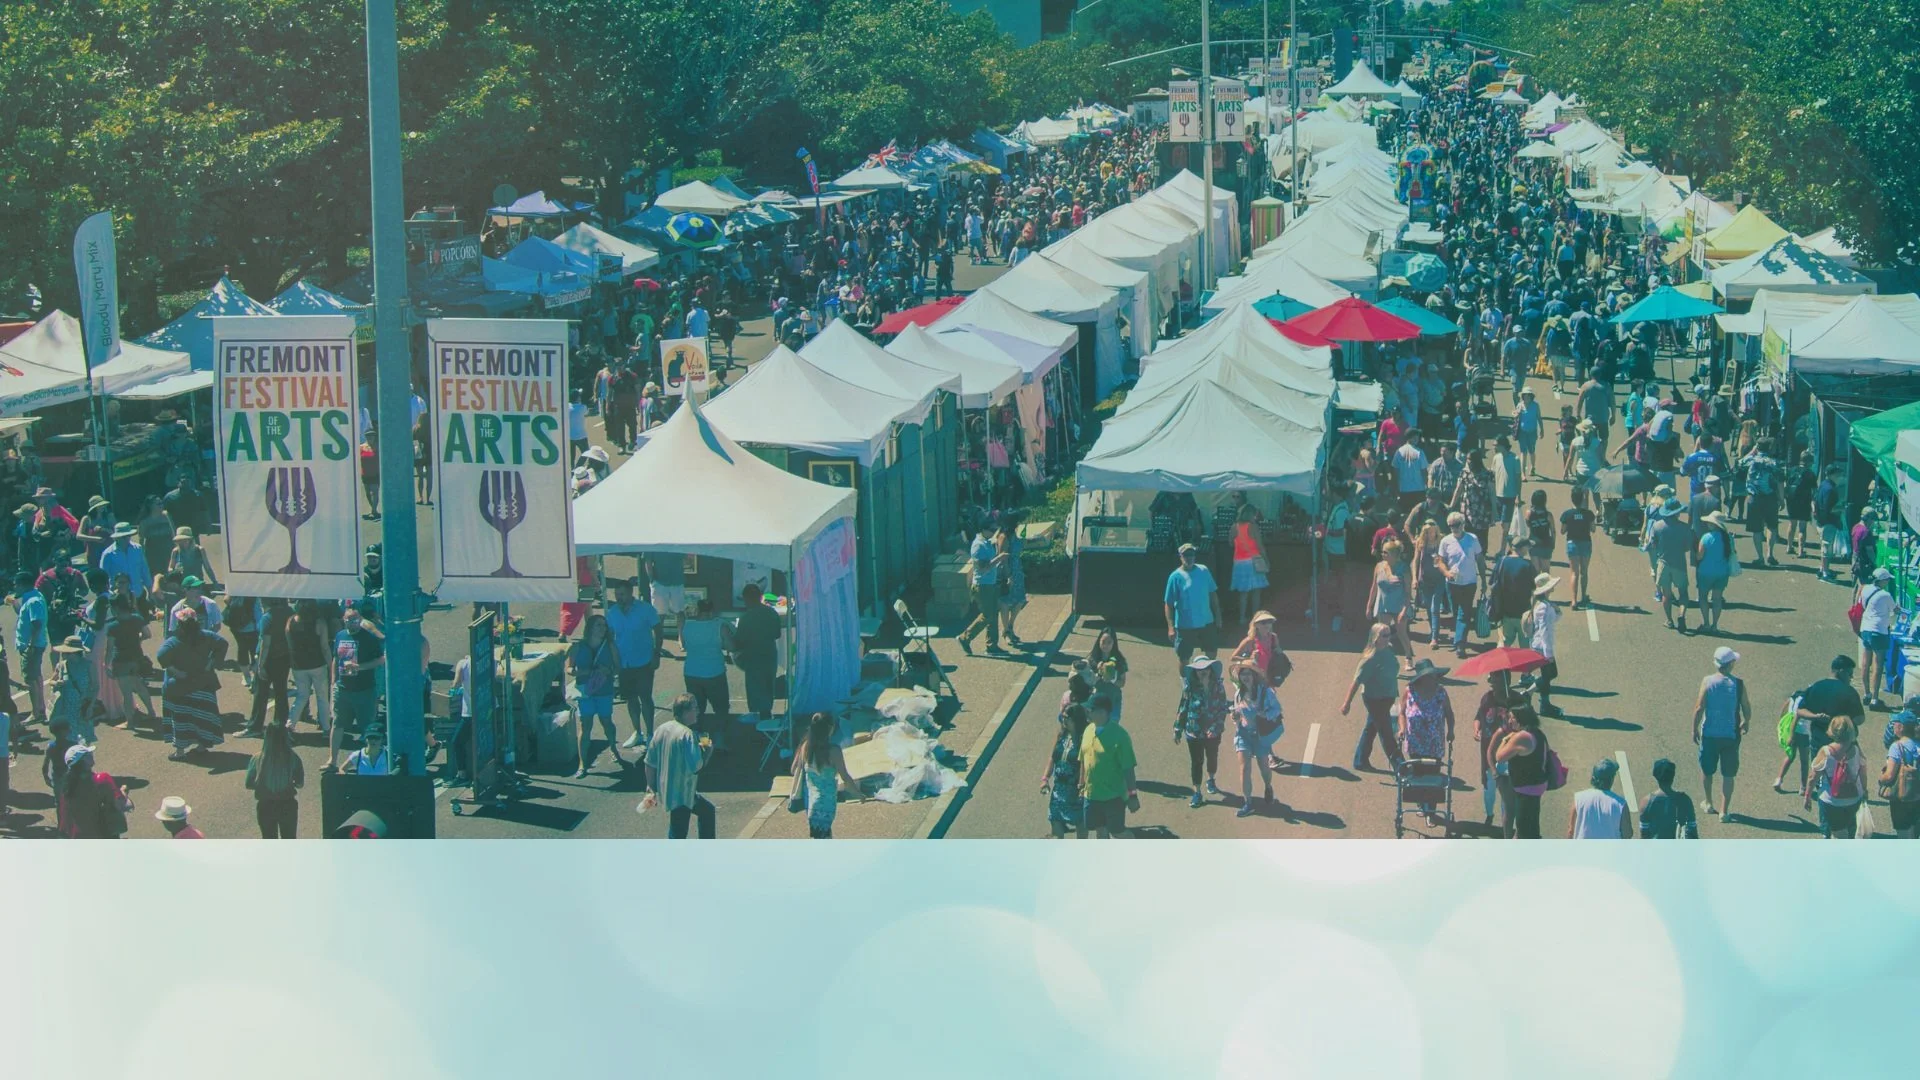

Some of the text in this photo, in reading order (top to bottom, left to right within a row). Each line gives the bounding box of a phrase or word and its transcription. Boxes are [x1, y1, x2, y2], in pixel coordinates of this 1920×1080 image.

[1271, 80, 1288, 88] ARTS
[1300, 80, 1317, 88] ARTS
[1171, 101, 1197, 112] ARTS
[1217, 100, 1243, 112] ARTS
[440, 245, 478, 263] POPCORN
[87, 240, 112, 346] Bloody Mary Mix
[225, 345, 346, 373] FREMONT
[440, 347, 556, 377] FREMONT
[224, 376, 349, 409] FESTIVAL
[440, 378, 558, 412] FESTIVAL
[267, 416, 279, 425] OF
[482, 418, 491, 428] OF
[226, 409, 350, 462] ARTS
[266, 425, 282, 435] THE
[480, 428, 495, 438] THE
[443, 413, 560, 466] ARTS
